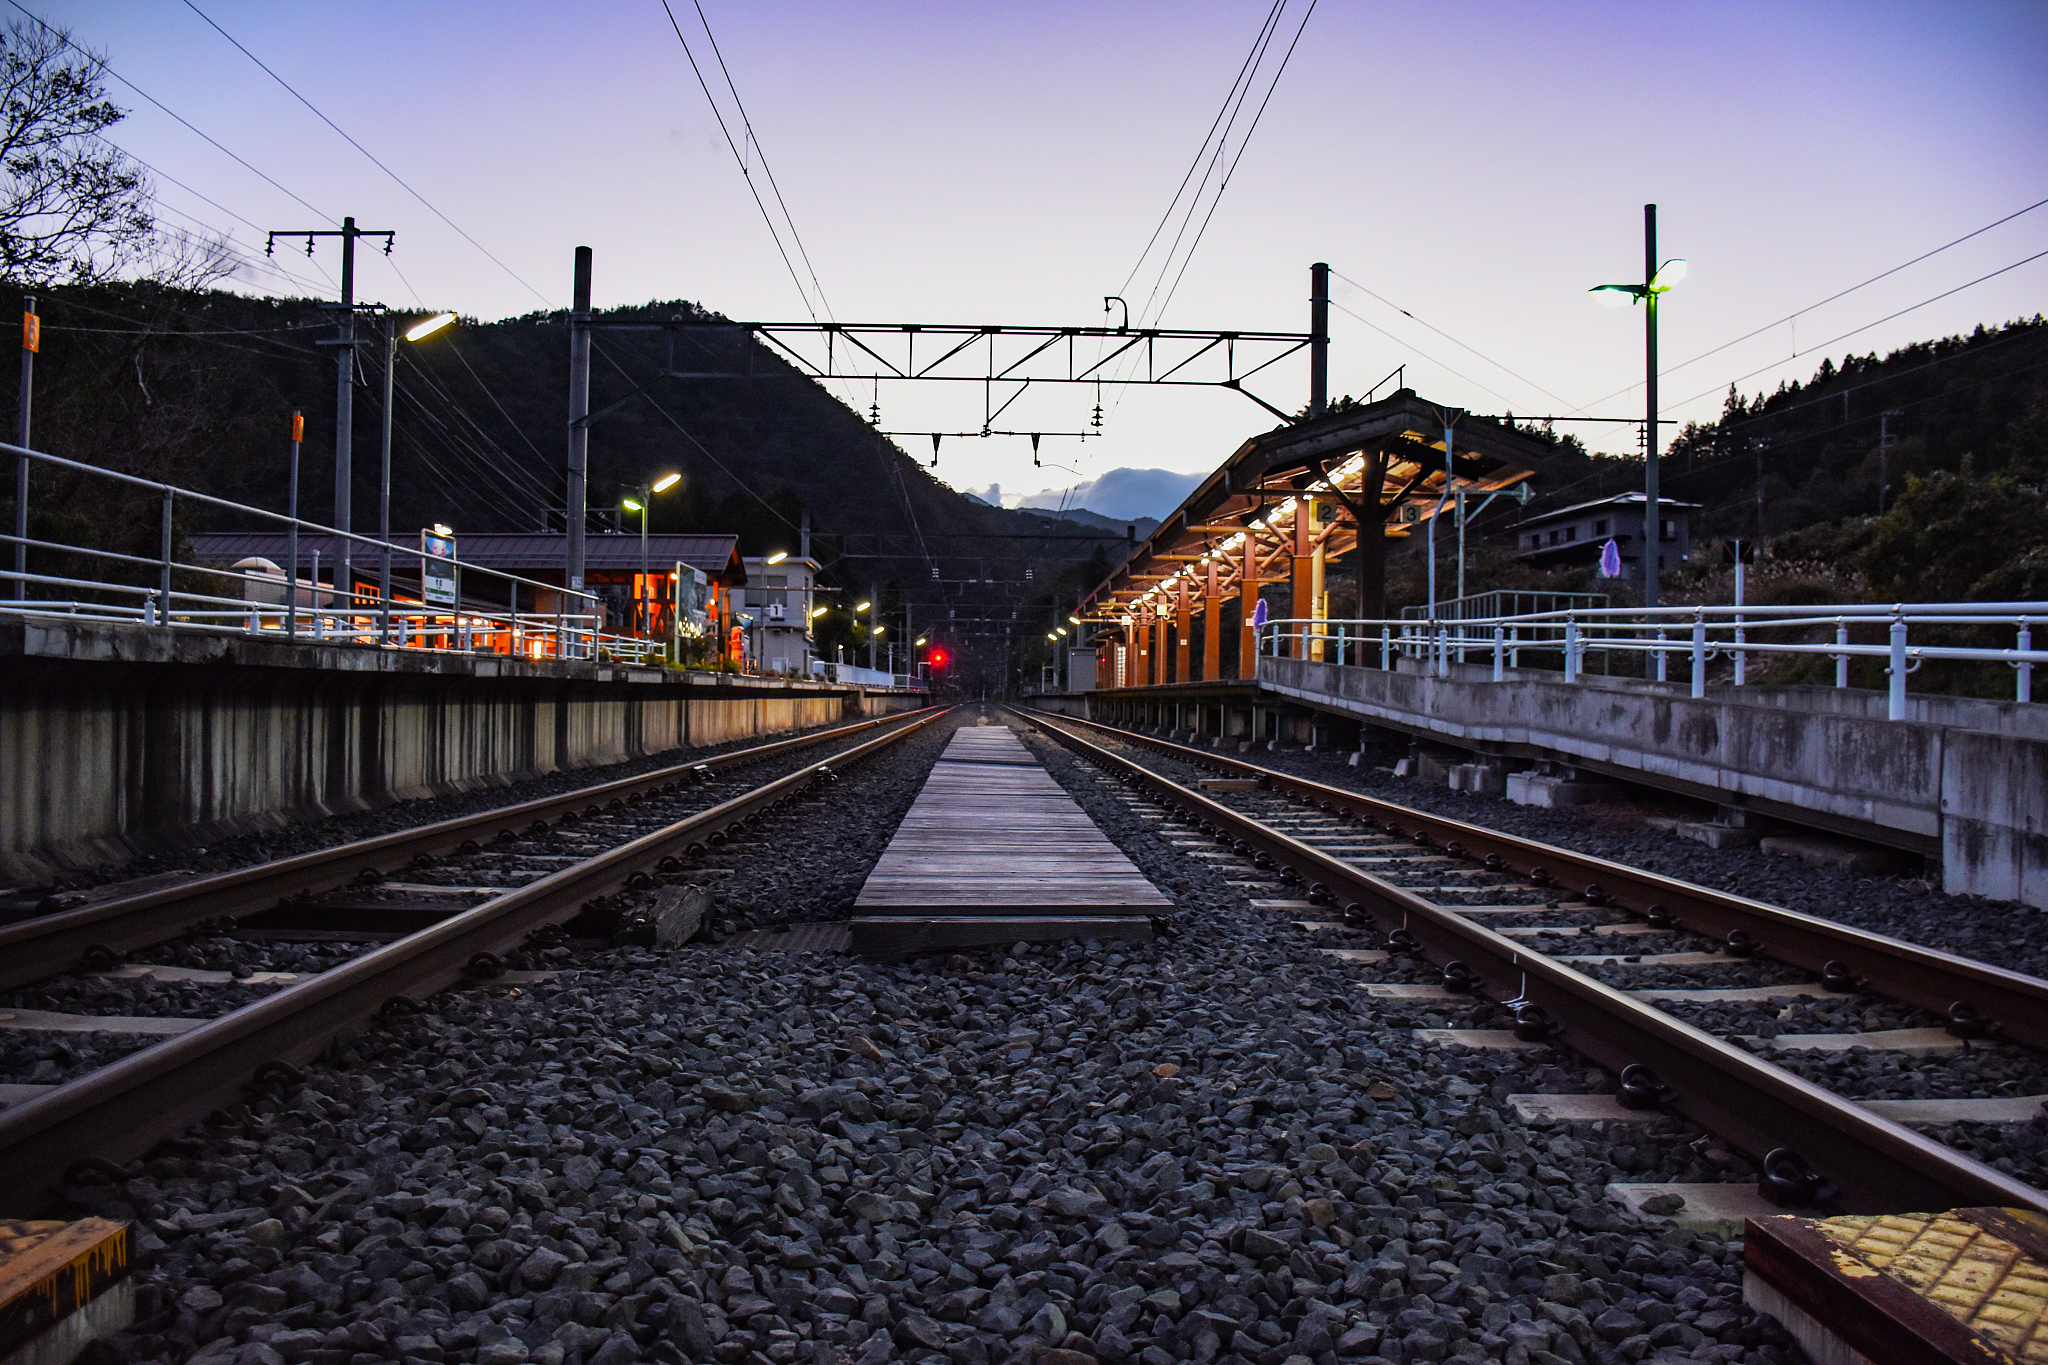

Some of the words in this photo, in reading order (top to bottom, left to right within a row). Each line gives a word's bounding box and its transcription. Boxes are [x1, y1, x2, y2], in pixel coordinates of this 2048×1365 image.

[28, 317, 36, 346] 6
[1321, 506, 1332, 520] 2
[1406, 507, 1417, 522] 3
[773, 605, 778, 616] 1
